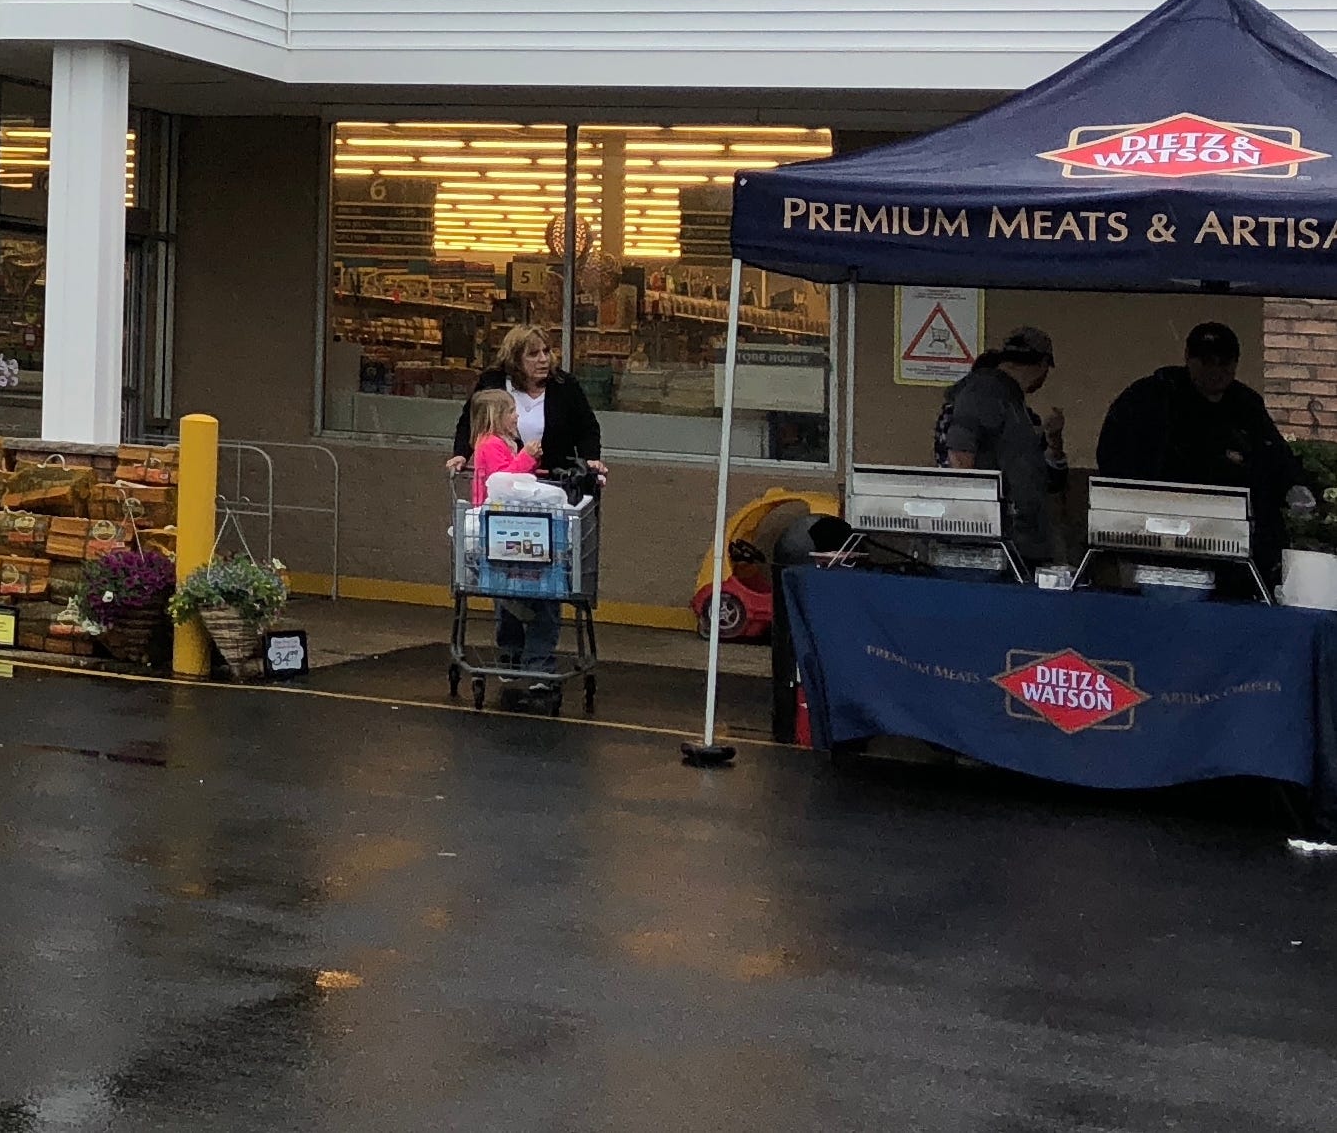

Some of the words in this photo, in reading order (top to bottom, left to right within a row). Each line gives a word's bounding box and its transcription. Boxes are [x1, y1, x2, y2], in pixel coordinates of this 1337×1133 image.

[1121, 132, 1227, 153] DIETZ
[1231, 135, 1262, 152] &
[1093, 147, 1262, 168] WATSON
[370, 179, 386, 201] 6
[783, 196, 970, 238] PREMIUM
[987, 205, 1129, 243] MEATS
[1146, 213, 1176, 244] &
[520, 270, 530, 284] 5
[769, 353, 810, 364] HOURS
[933, 665, 981, 684] MEATS
[1035, 665, 1093, 690] DIETZ
[1095, 672, 1111, 692] &
[1021, 681, 1114, 712] WATSON
